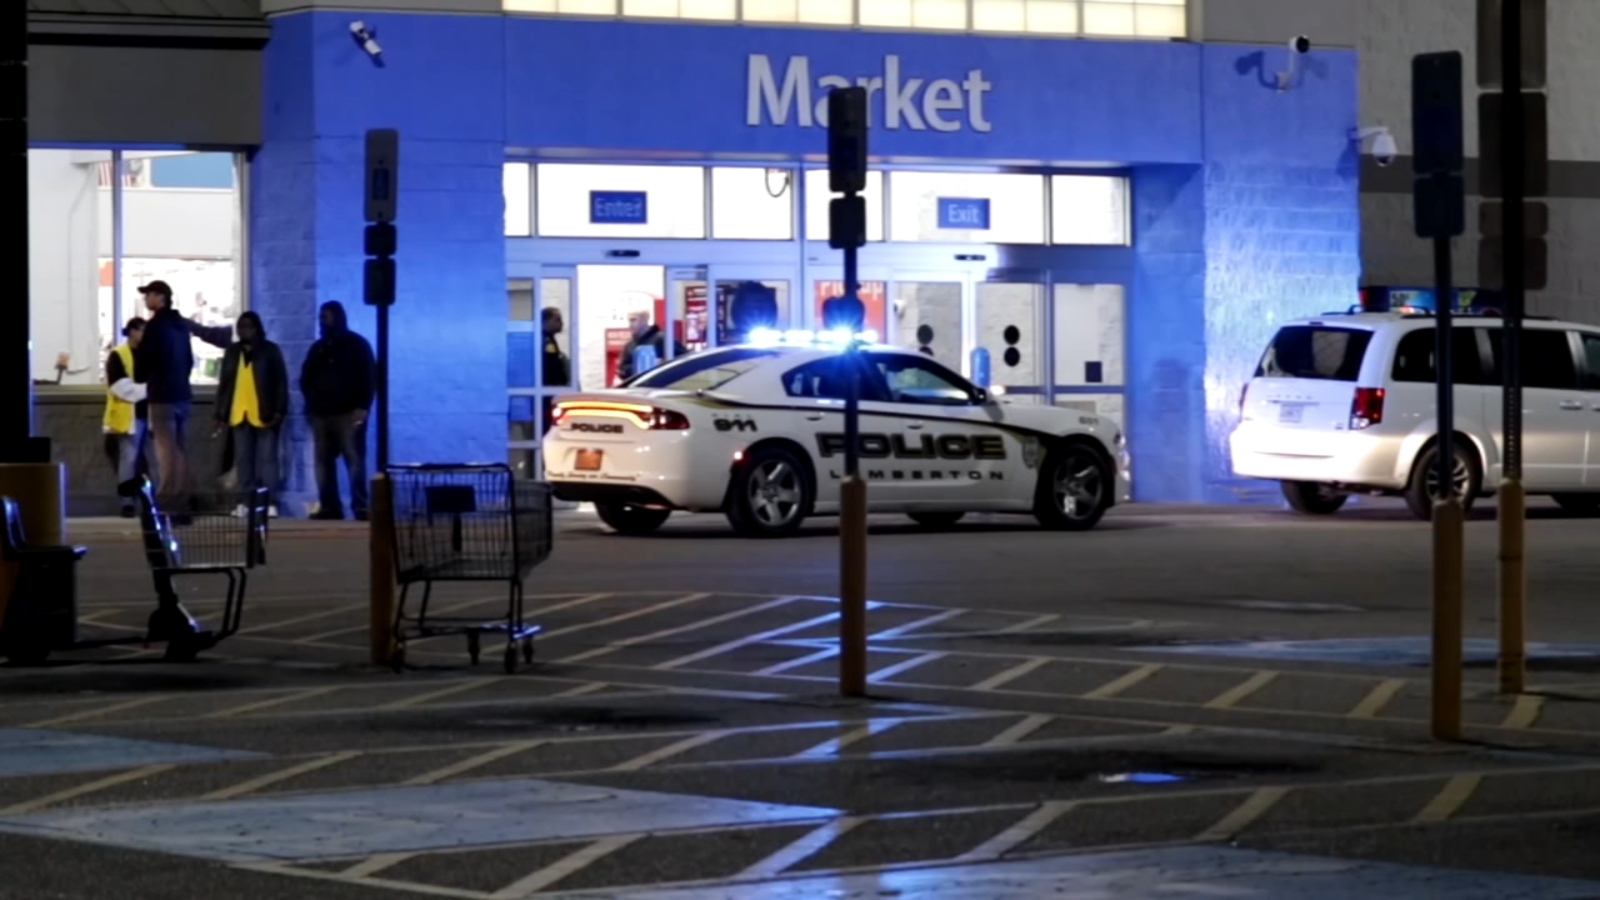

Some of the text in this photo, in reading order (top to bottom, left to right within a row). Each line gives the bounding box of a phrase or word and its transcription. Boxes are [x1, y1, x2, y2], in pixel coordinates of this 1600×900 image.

[595, 197, 642, 217] Enter
[949, 204, 979, 223] Exit
[571, 422, 624, 434] POLICE
[713, 418, 758, 432] 911
[815, 432, 1007, 460] POLICE
[830, 470, 1004, 480] LMBERTON
